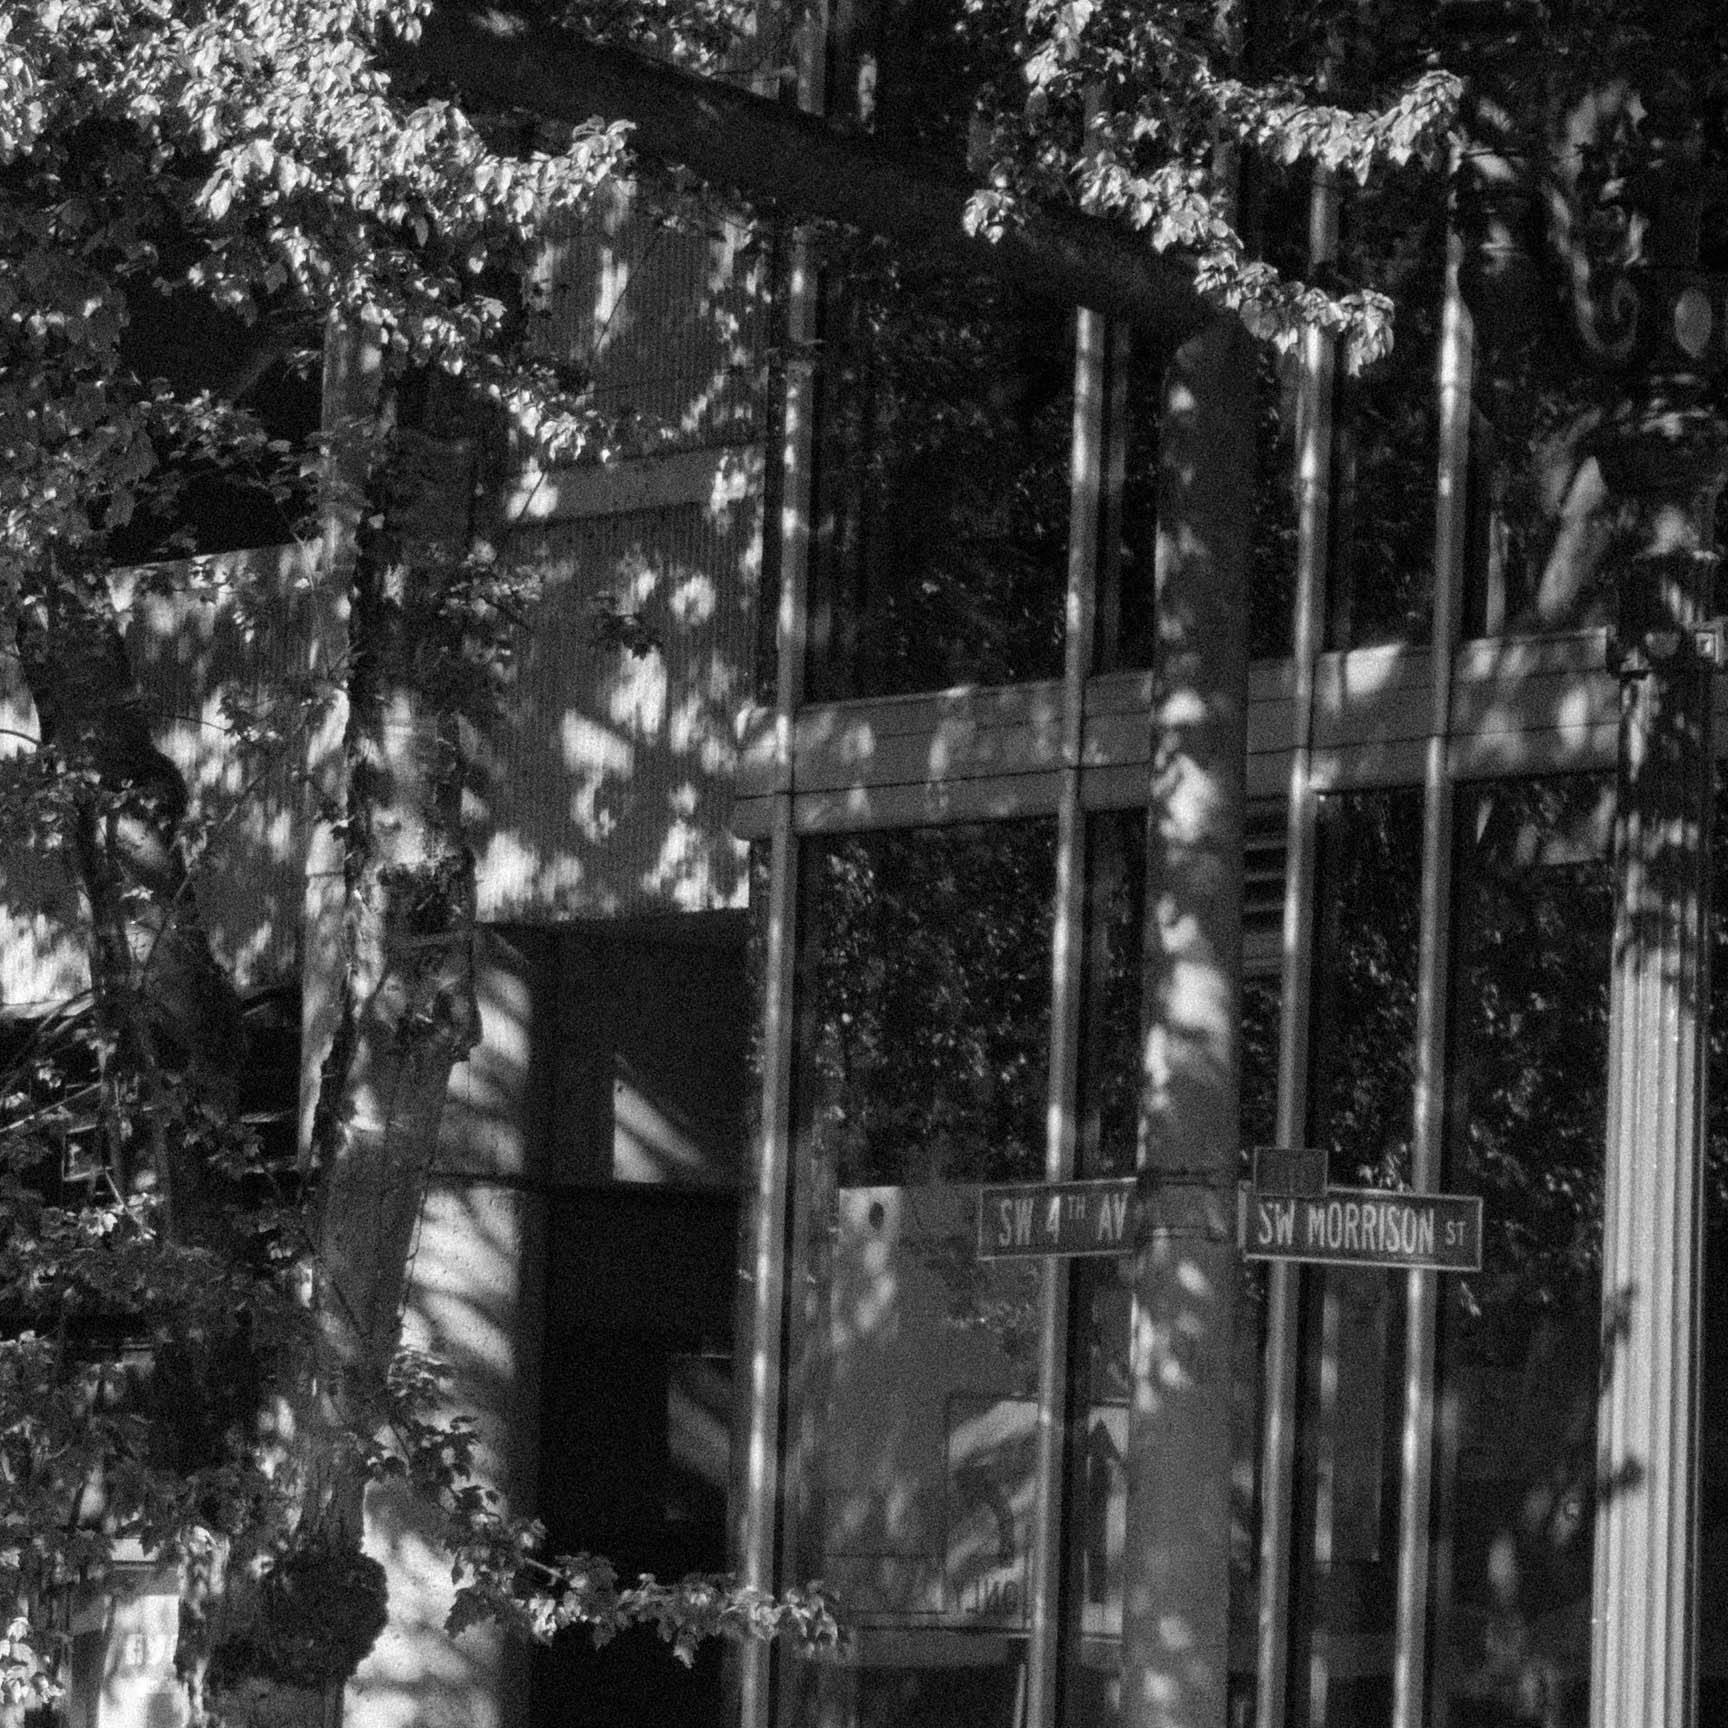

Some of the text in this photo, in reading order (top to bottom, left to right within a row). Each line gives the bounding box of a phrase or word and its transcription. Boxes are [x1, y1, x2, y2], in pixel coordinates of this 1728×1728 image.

[998, 1197, 1033, 1247] SW
[1097, 1191, 1128, 1241] AV
[1258, 1198, 1466, 1254] SW MORRISON ST
